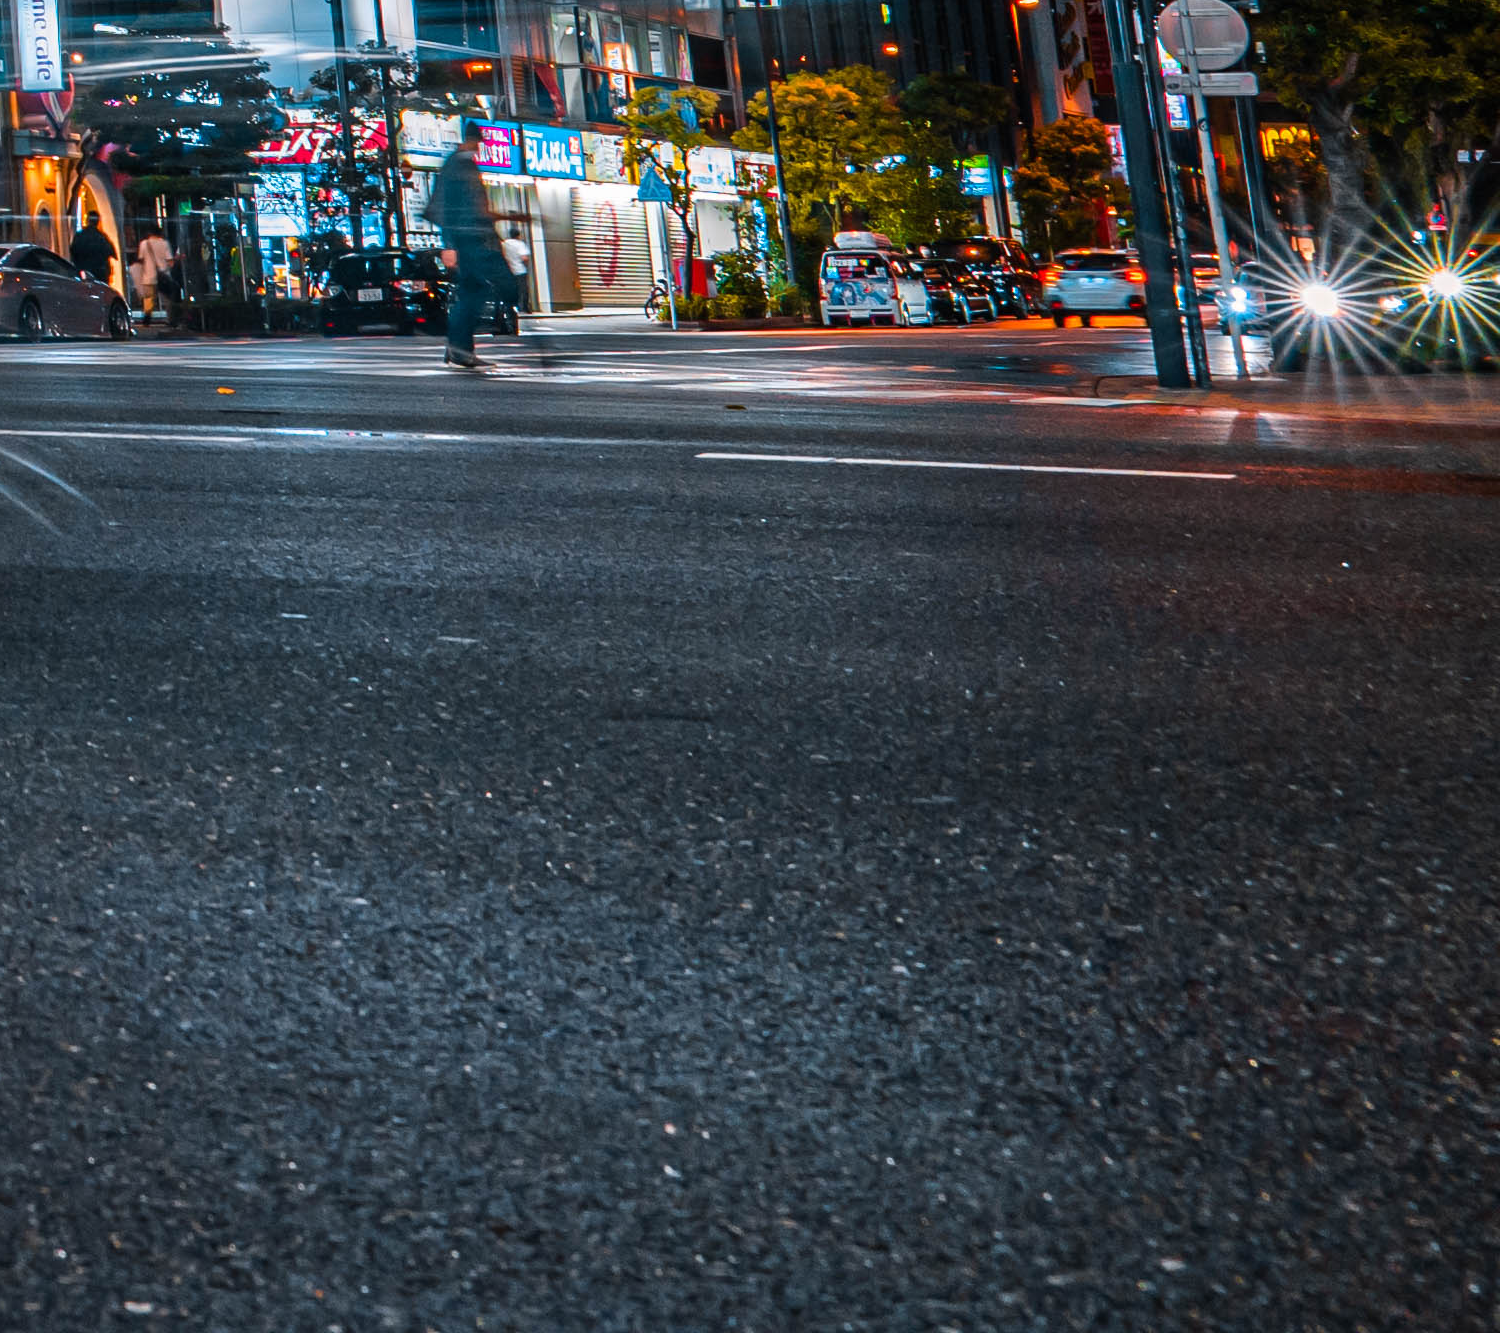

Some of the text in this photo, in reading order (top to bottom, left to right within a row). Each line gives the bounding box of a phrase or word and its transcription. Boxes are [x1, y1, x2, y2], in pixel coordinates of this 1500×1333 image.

[525, 136, 571, 179] らしんばん
